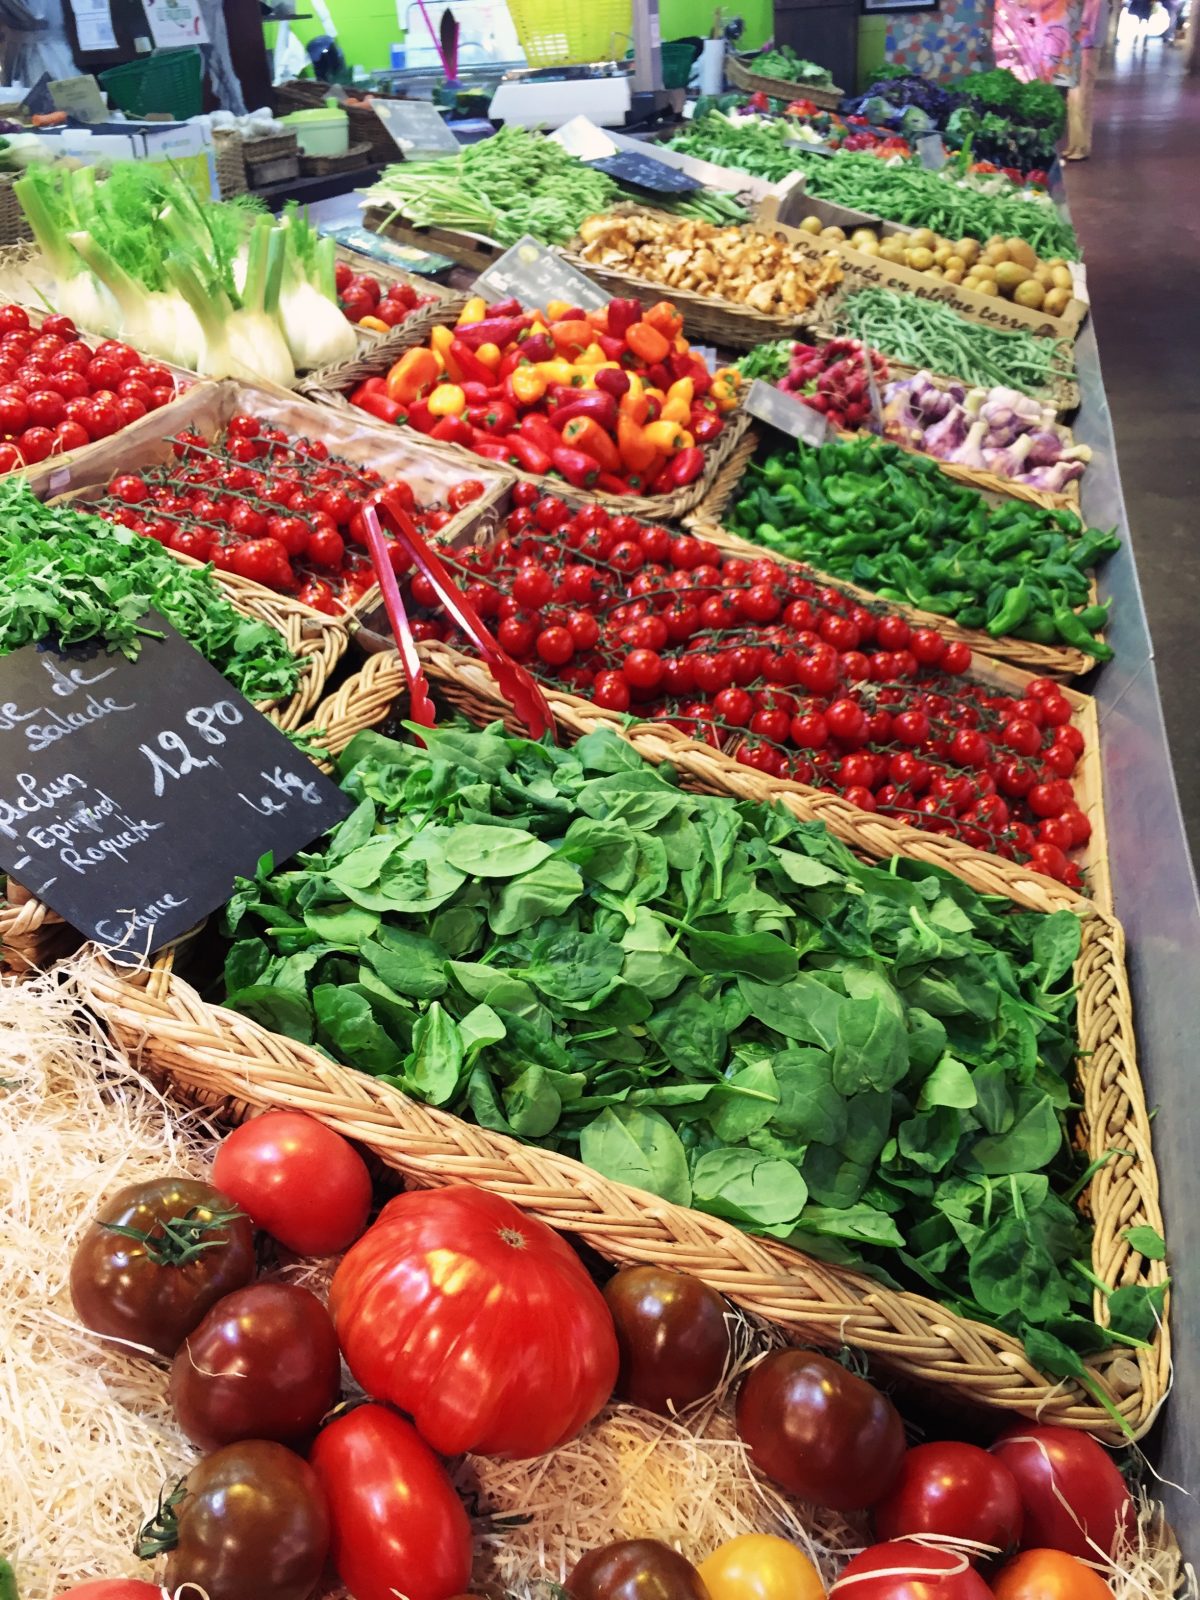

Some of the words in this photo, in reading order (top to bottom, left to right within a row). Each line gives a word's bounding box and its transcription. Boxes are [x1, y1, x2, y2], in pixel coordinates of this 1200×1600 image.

[887, 278, 910, 292] en
[41, 655, 117, 696] de
[25, 693, 137, 752] Salade
[138, 701, 243, 797] 12,80
[60, 813, 165, 875] Roquette
[95, 893, 189, 946] France
